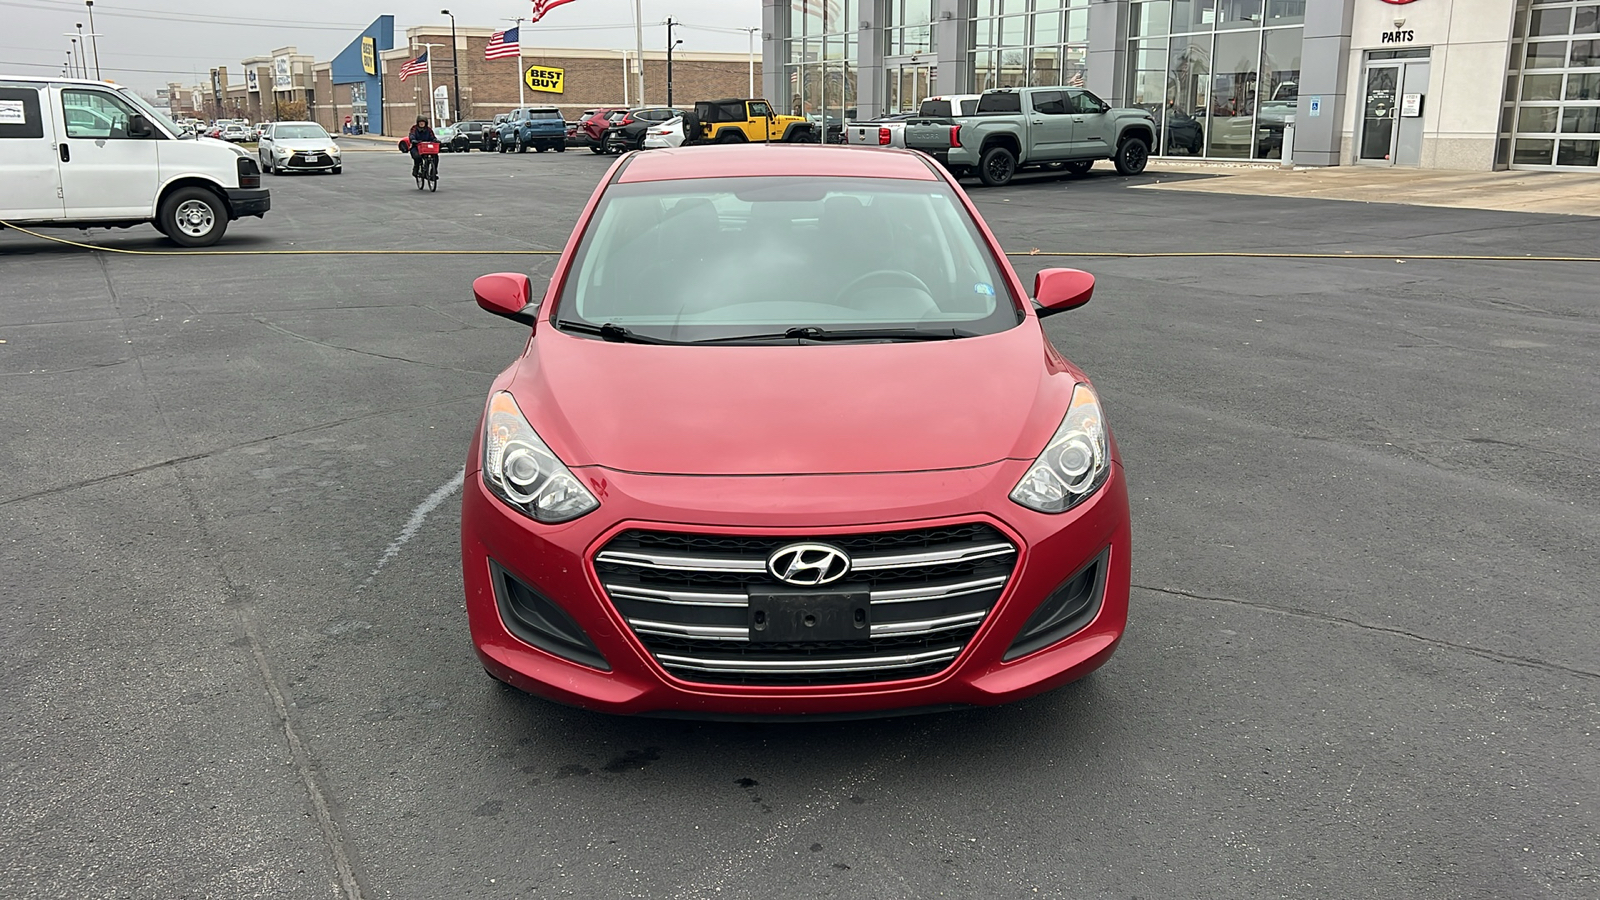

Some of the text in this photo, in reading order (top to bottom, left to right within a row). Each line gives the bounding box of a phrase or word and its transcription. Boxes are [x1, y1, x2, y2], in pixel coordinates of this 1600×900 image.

[1381, 30, 1414, 43] PARTS
[531, 69, 562, 80] BEST
[532, 78, 559, 88] BUY
